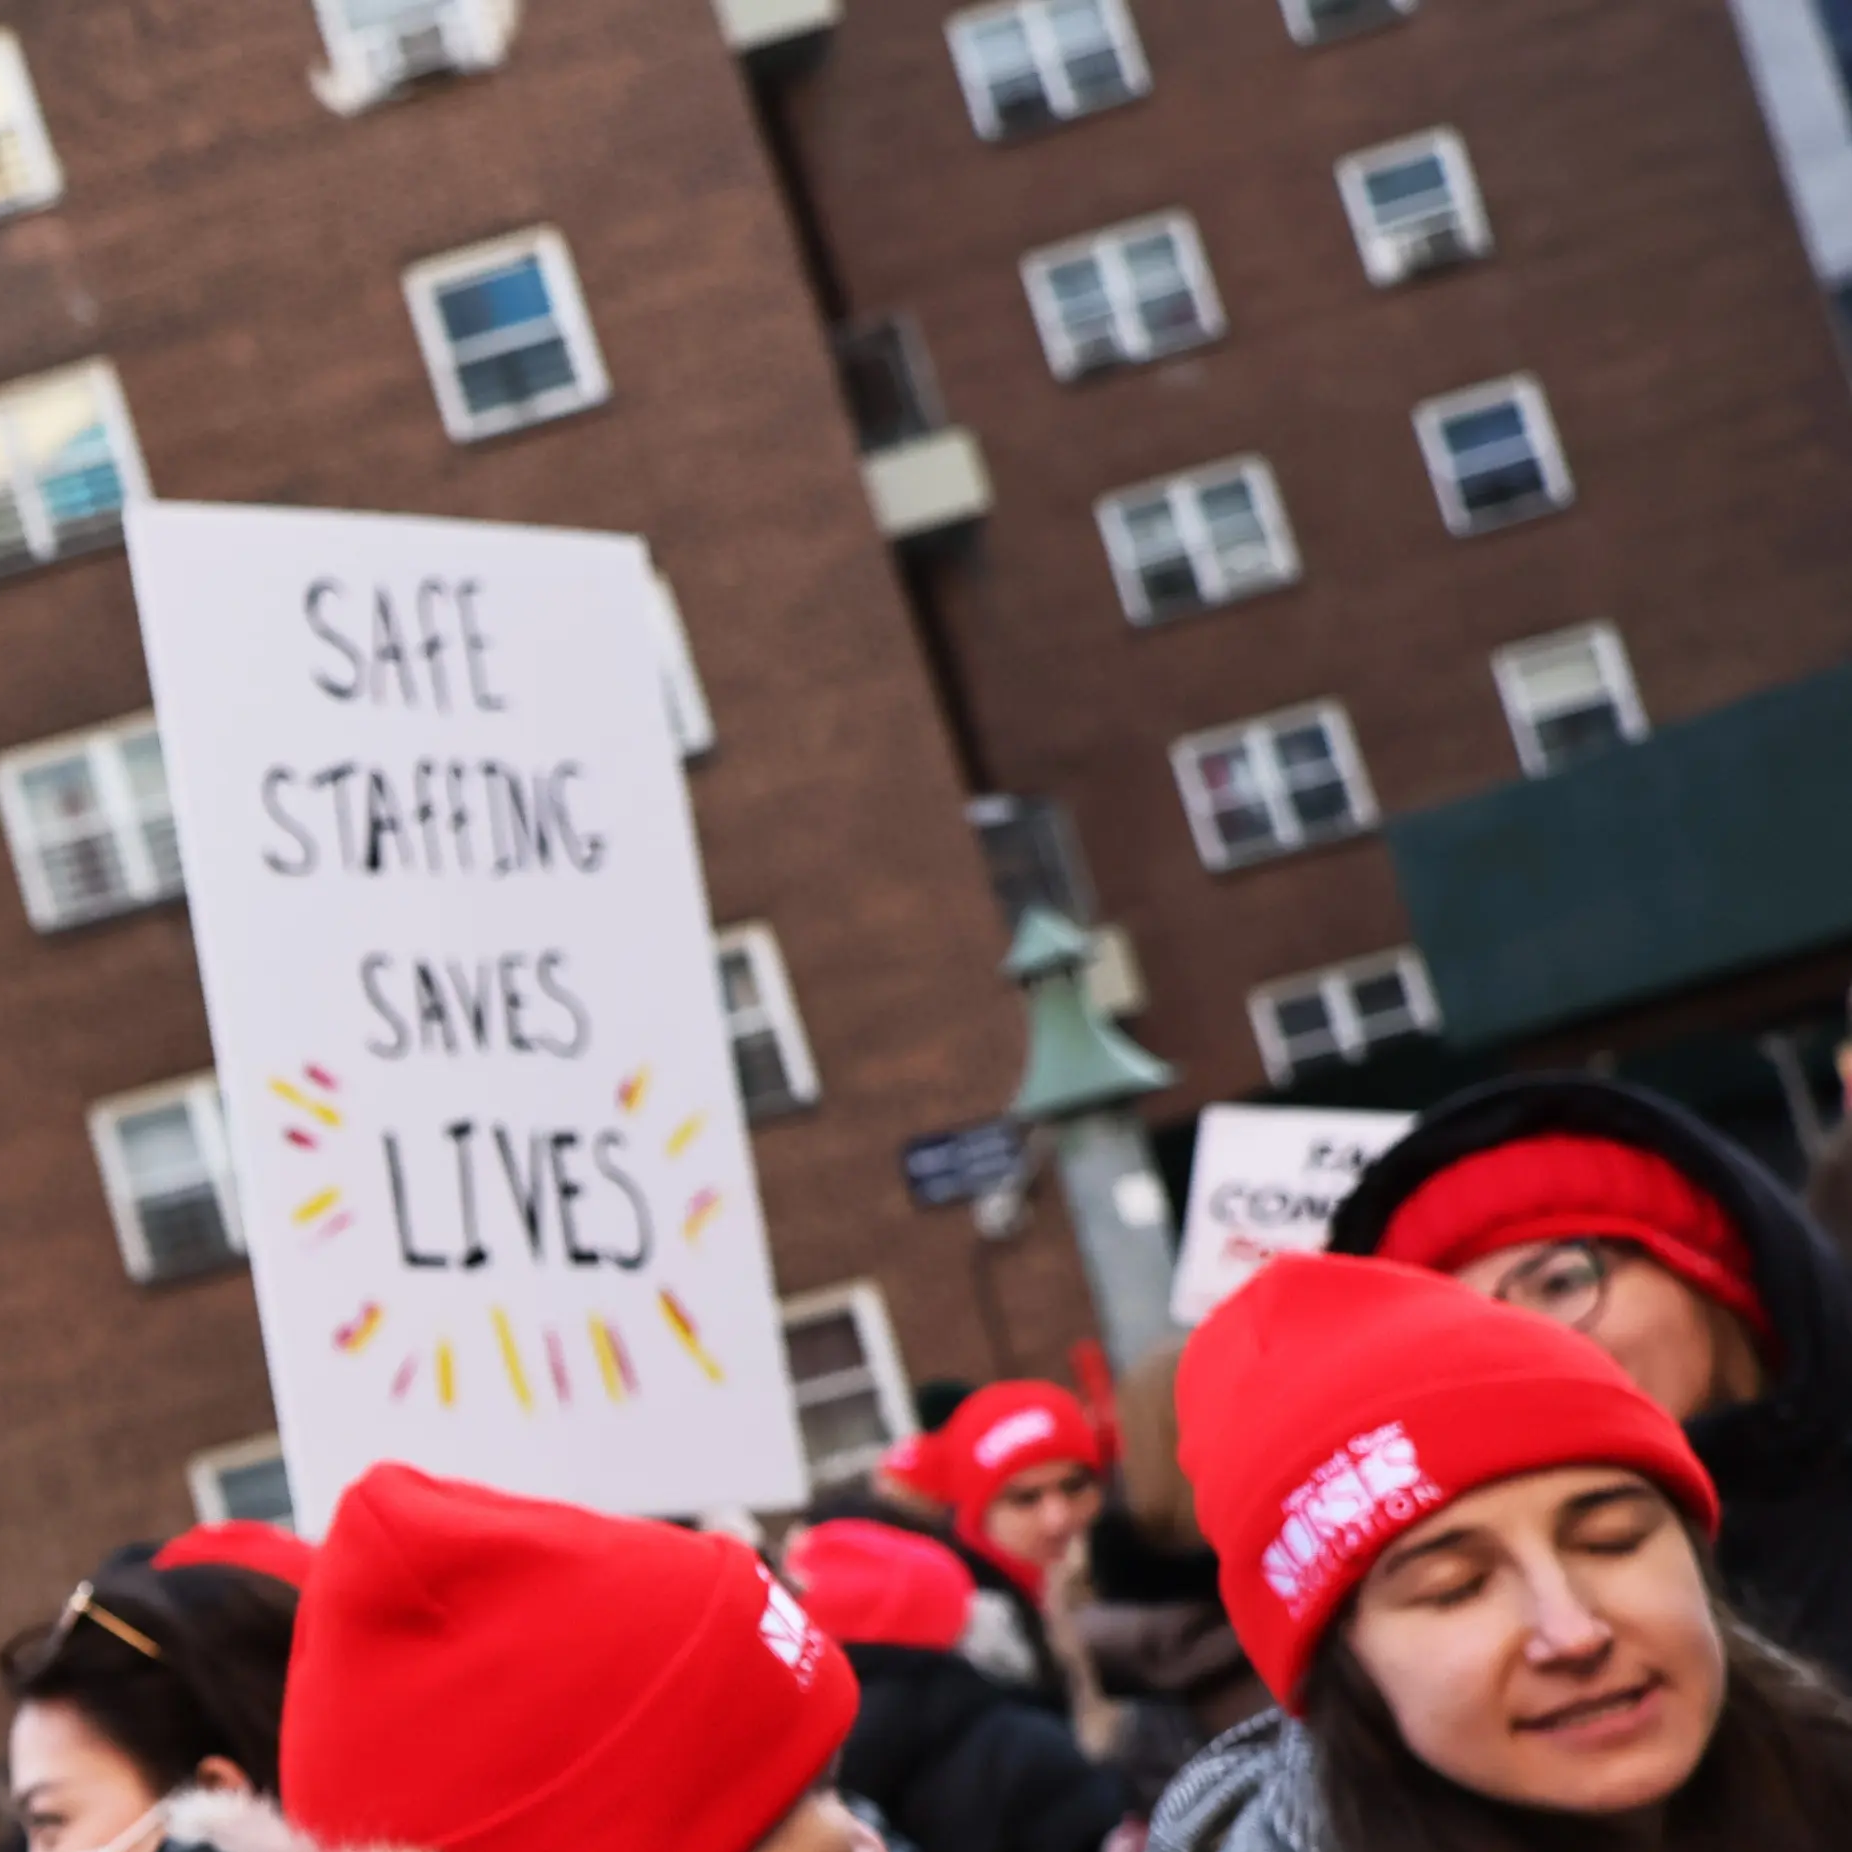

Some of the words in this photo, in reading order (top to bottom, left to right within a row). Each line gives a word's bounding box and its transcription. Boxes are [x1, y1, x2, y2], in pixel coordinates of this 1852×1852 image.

[304, 576, 510, 712] SAFE
[260, 760, 606, 879] STAFFING
[358, 950, 592, 1059] SAVES
[381, 1120, 655, 1271] LIVES
